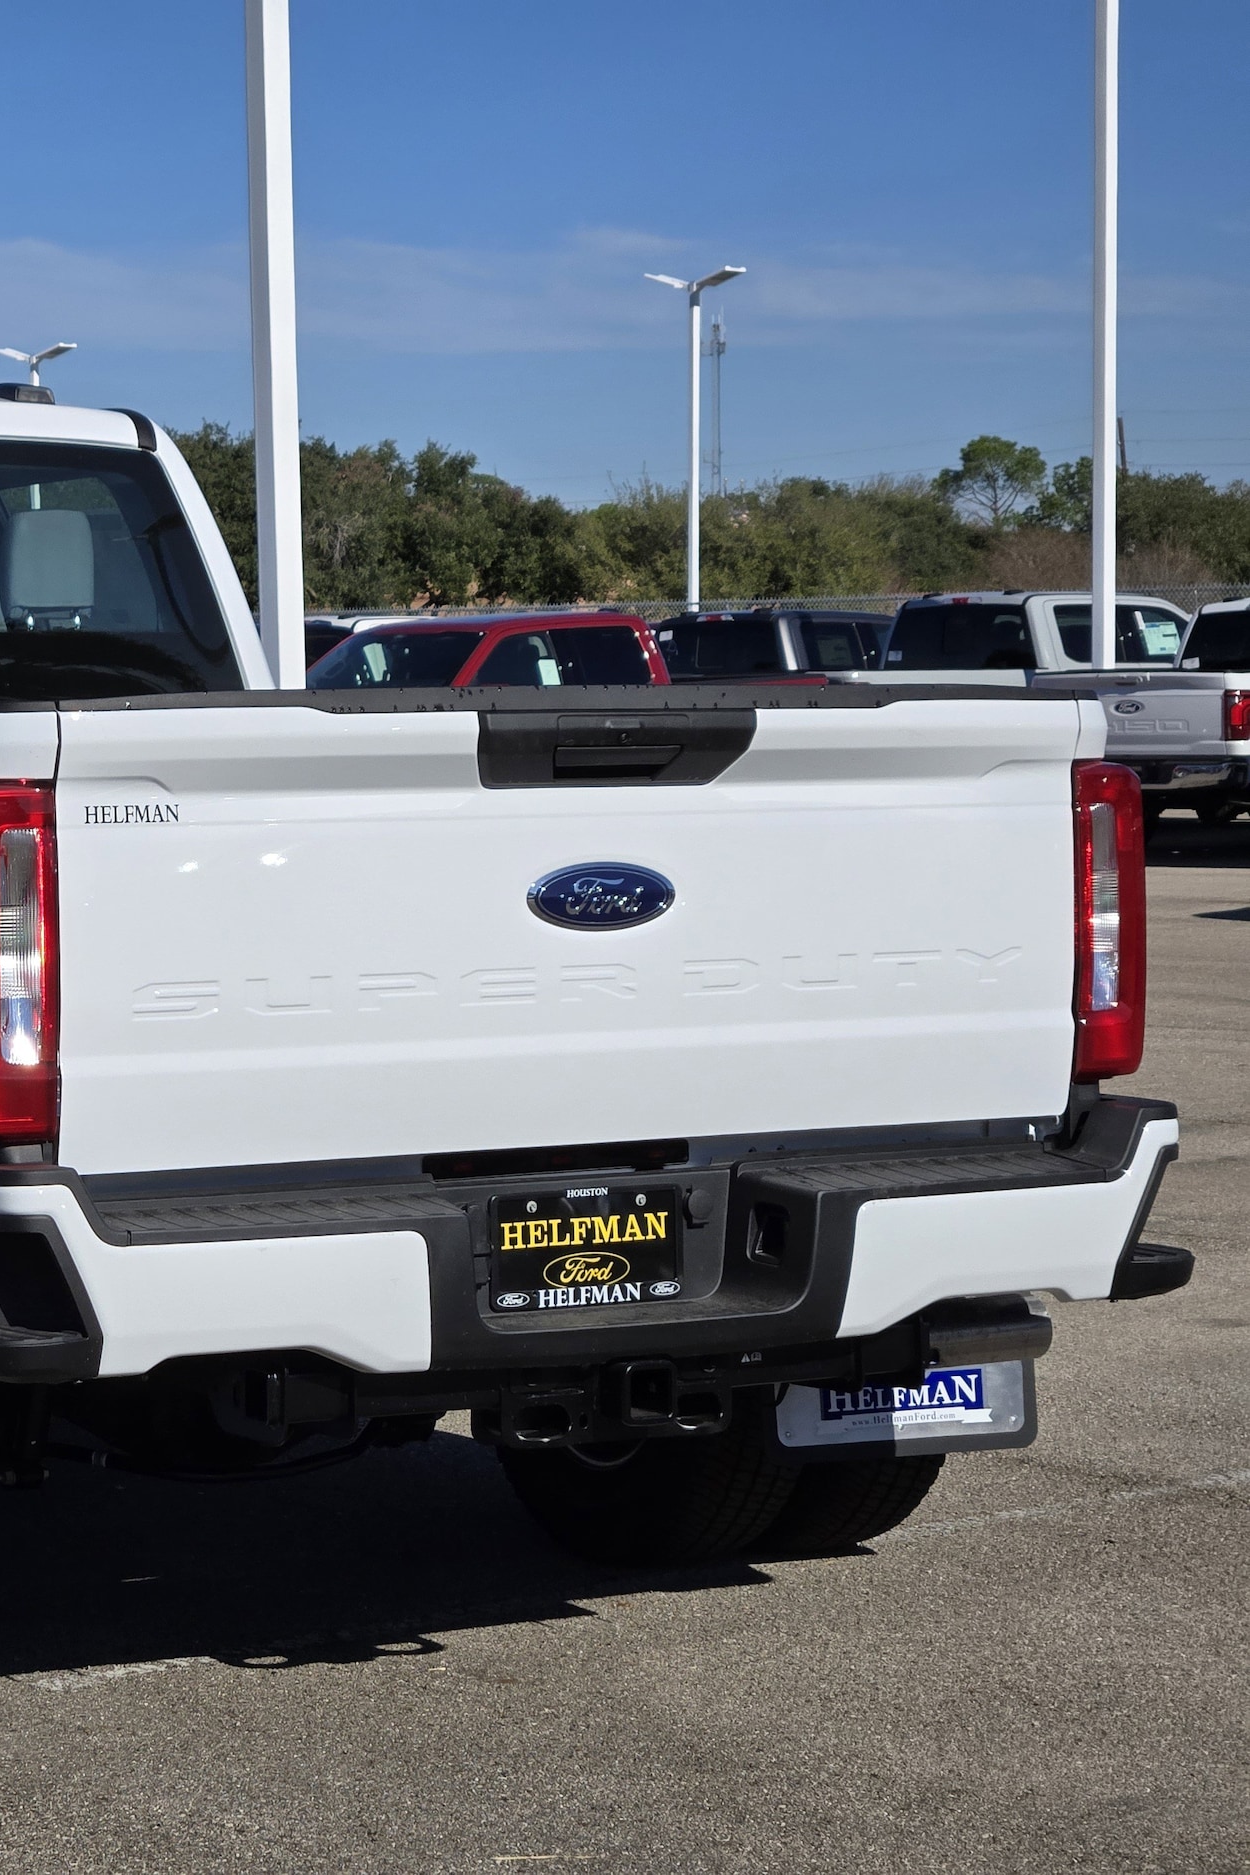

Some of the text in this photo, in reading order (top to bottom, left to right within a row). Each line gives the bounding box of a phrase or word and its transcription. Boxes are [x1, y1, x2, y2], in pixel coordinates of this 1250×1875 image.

[84, 804, 179, 824] HELFMAN
[133, 946, 1022, 1021] SUPER DUTY
[566, 1187, 608, 1198] HOUSTON
[501, 1211, 669, 1250] HELFMAN
[560, 1256, 614, 1284] Ford
[538, 1282, 644, 1308] HELFMAN
[827, 1374, 979, 1413] HELFMAN
